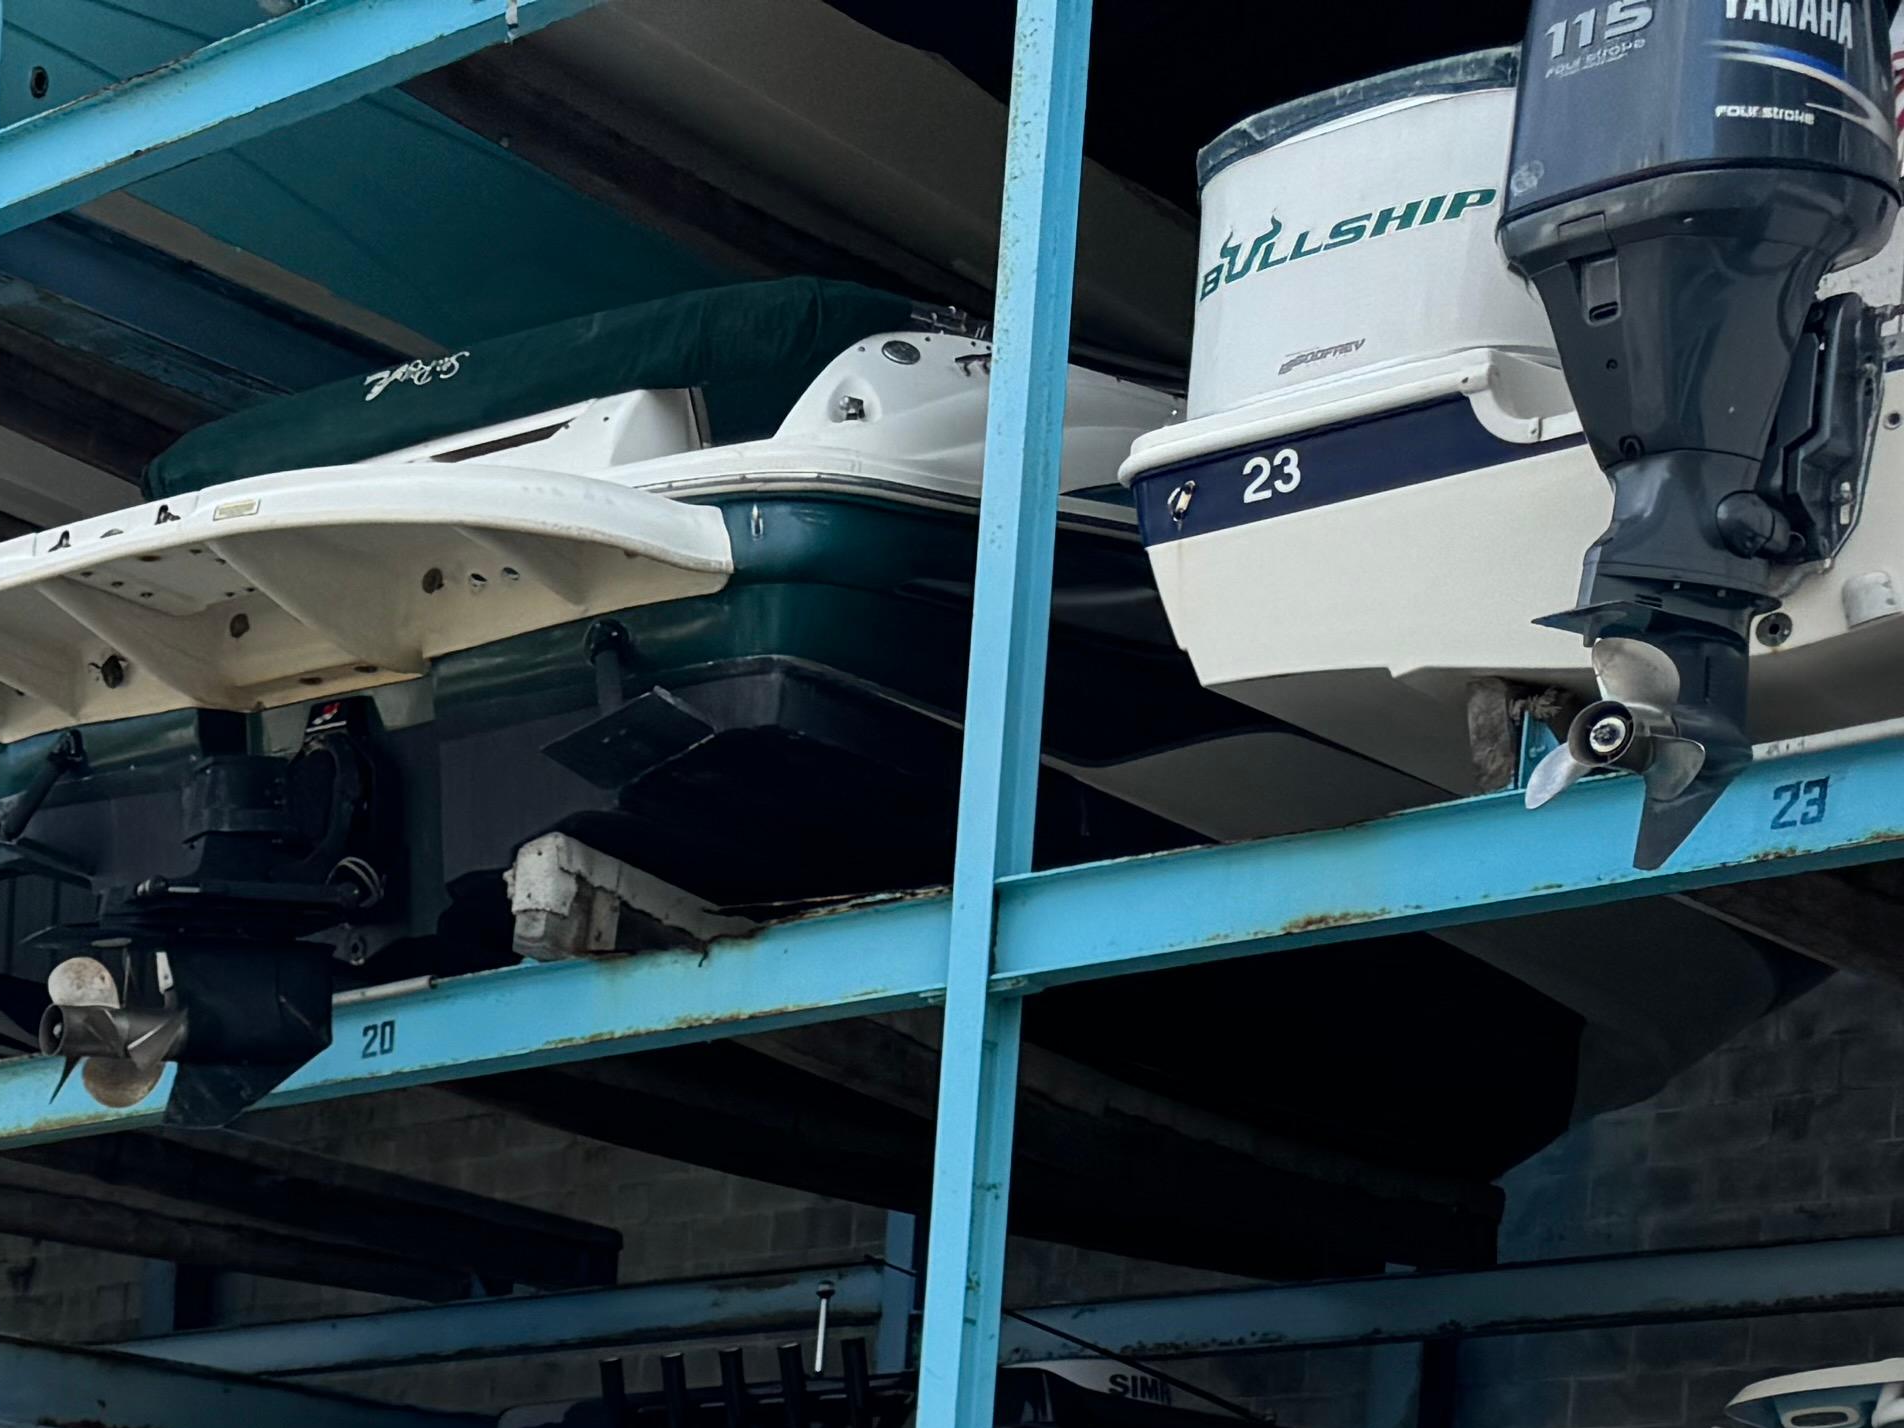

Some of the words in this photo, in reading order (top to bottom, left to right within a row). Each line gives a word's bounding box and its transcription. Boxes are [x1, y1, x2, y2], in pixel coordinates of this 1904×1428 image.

[1545, 0, 1654, 59] 115
[1199, 188, 1497, 302] BULLSHIP
[1243, 448, 1301, 504] 23
[1770, 775, 1831, 830] 23
[361, 1019, 396, 1059] 20
